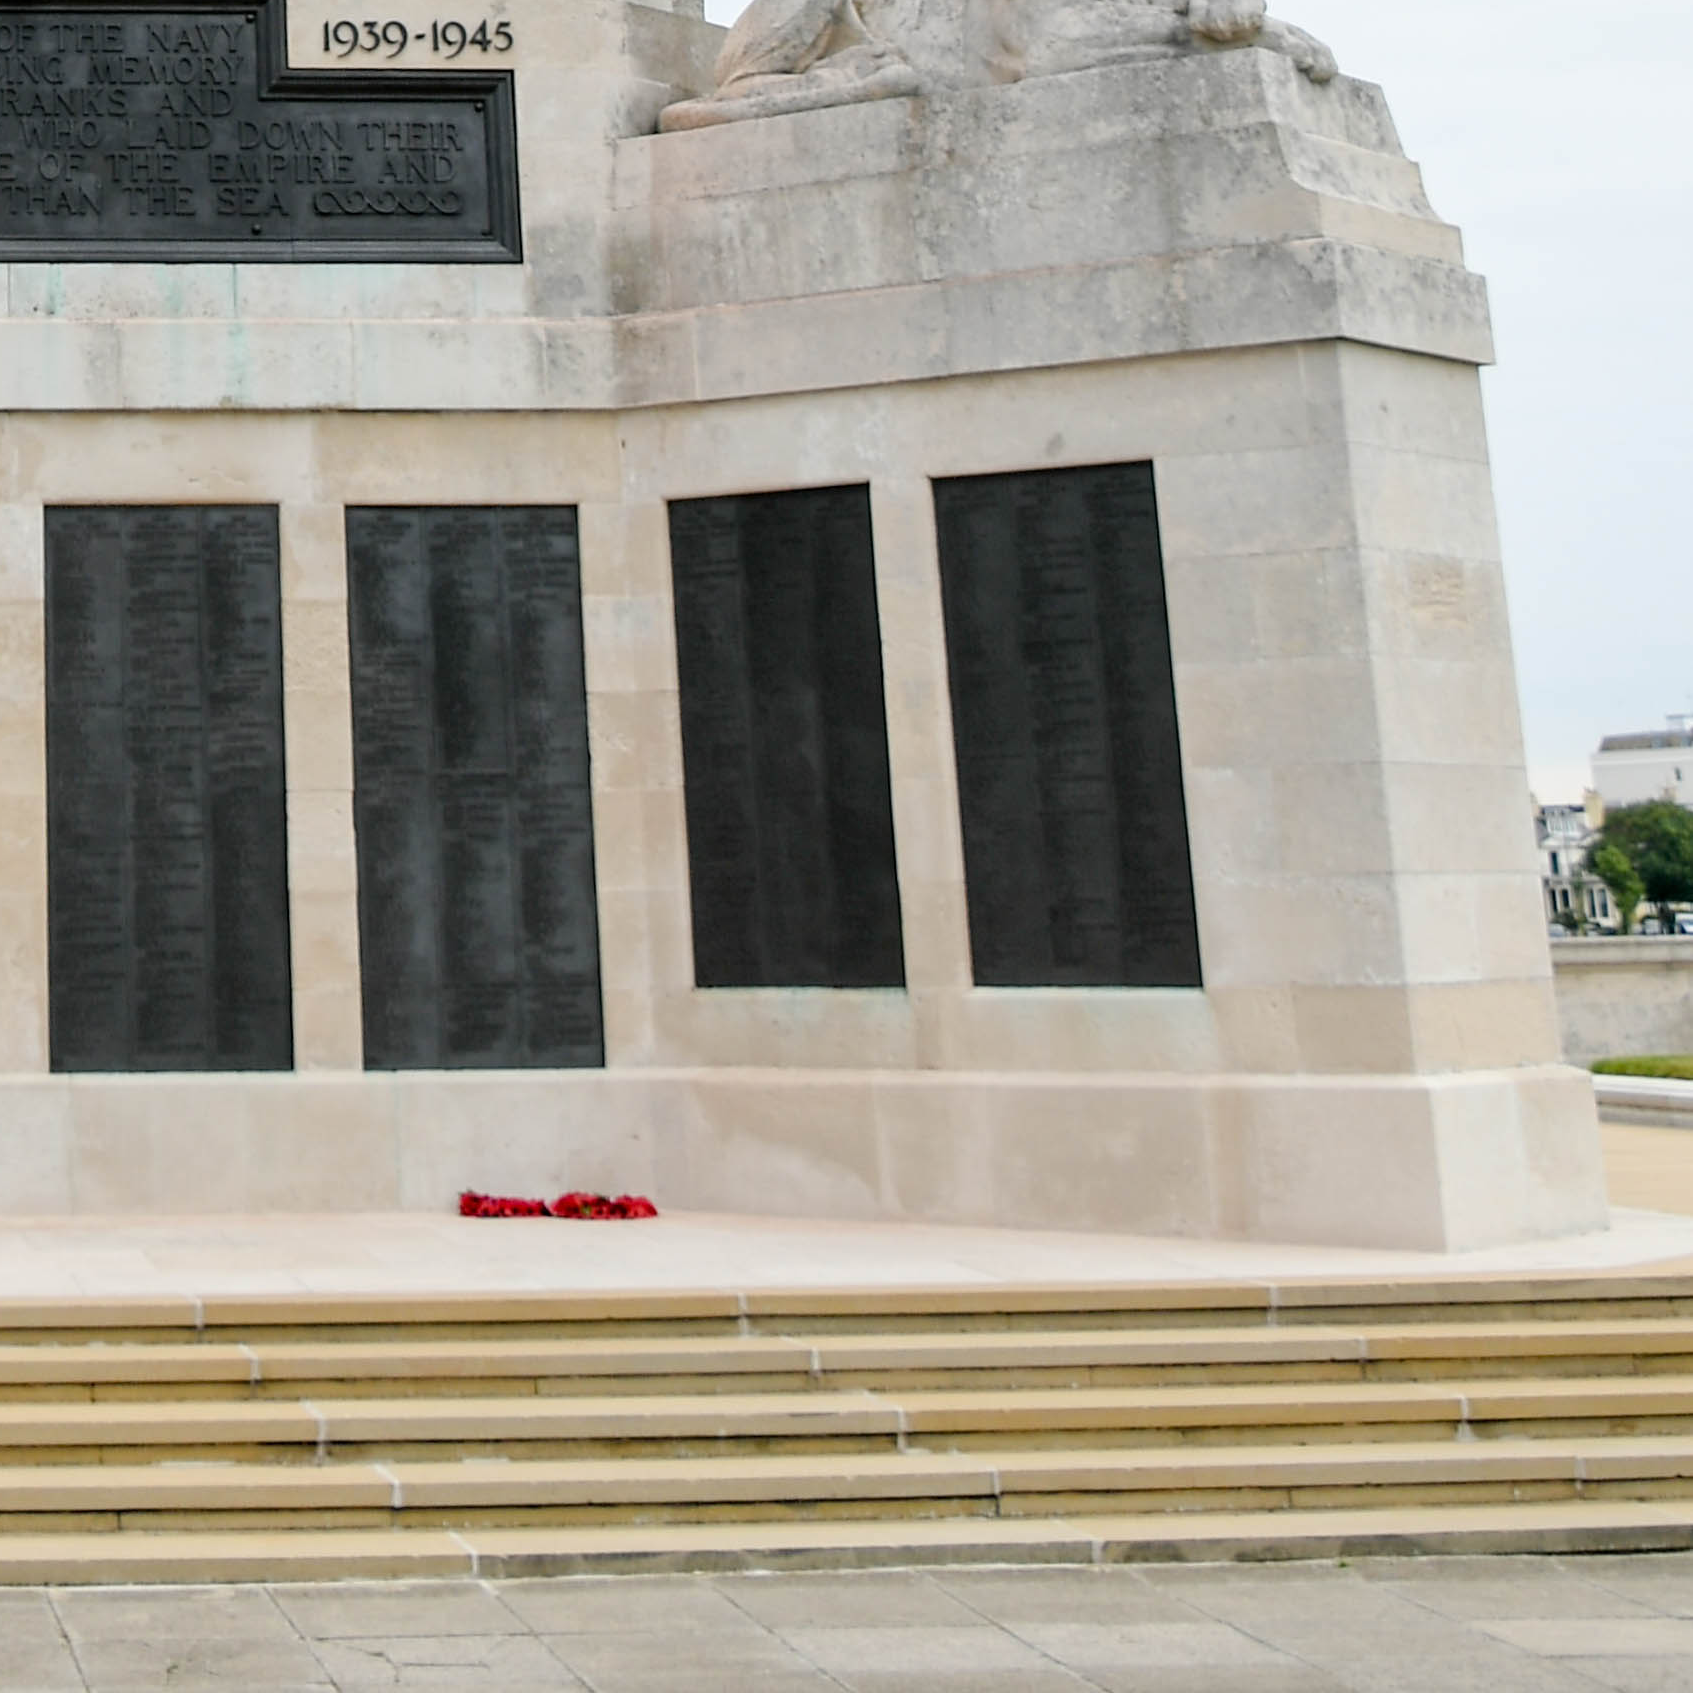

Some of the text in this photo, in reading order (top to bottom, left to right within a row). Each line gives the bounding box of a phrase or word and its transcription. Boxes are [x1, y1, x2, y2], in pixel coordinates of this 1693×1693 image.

[50, 24, 123, 54] THE
[145, 24, 244, 54] NAVY
[322, 19, 513, 59] 1939-1945
[87, 56, 244, 85] MEMORY
[0, 88, 128, 117] RANKS
[156, 88, 234, 117] AND
[19, 120, 101, 149] WHO
[126, 120, 211, 150] LAID
[238, 120, 343, 151] DOWN
[357, 121, 463, 151] THEIR
[38, 153, 83, 182] OF
[104, 153, 180, 183] THE
[207, 154, 354, 183] EMPIRE
[377, 155, 455, 184] AND
[1, 186, 103, 216] THAN
[122, 186, 195, 216] THE
[216, 187, 289, 216] SEA
